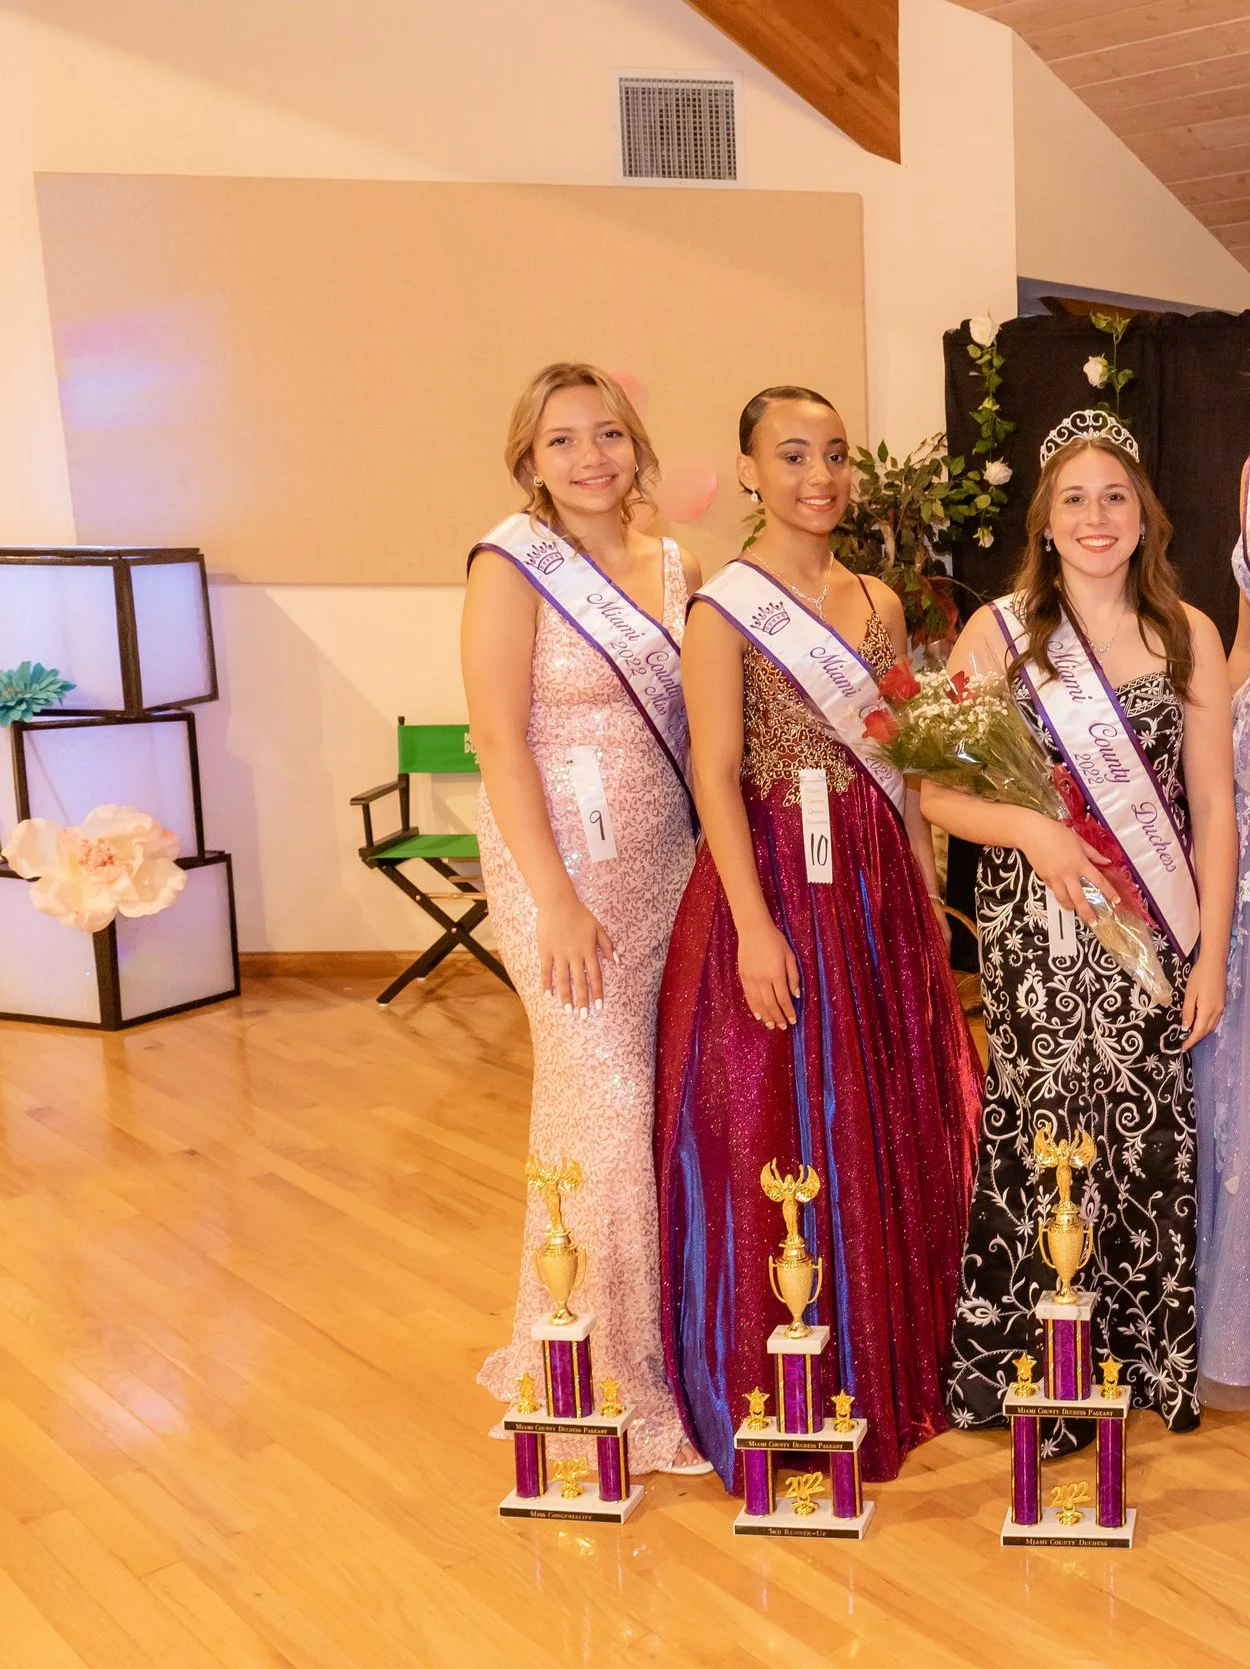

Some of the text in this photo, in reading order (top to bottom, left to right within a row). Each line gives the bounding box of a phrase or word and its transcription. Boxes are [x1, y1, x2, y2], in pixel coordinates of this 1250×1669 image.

[587, 593, 645, 642] Miami
[610, 641, 667, 716] 2022 Miss
[810, 647, 861, 698] Miami
[865, 757, 893, 782] 2022
[1047, 639, 1177, 873] Miami County Duchess
[1074, 753, 1104, 785] 2022
[590, 810, 605, 840] 9
[810, 833, 828, 867] 10
[785, 1471, 825, 1499] 2022
